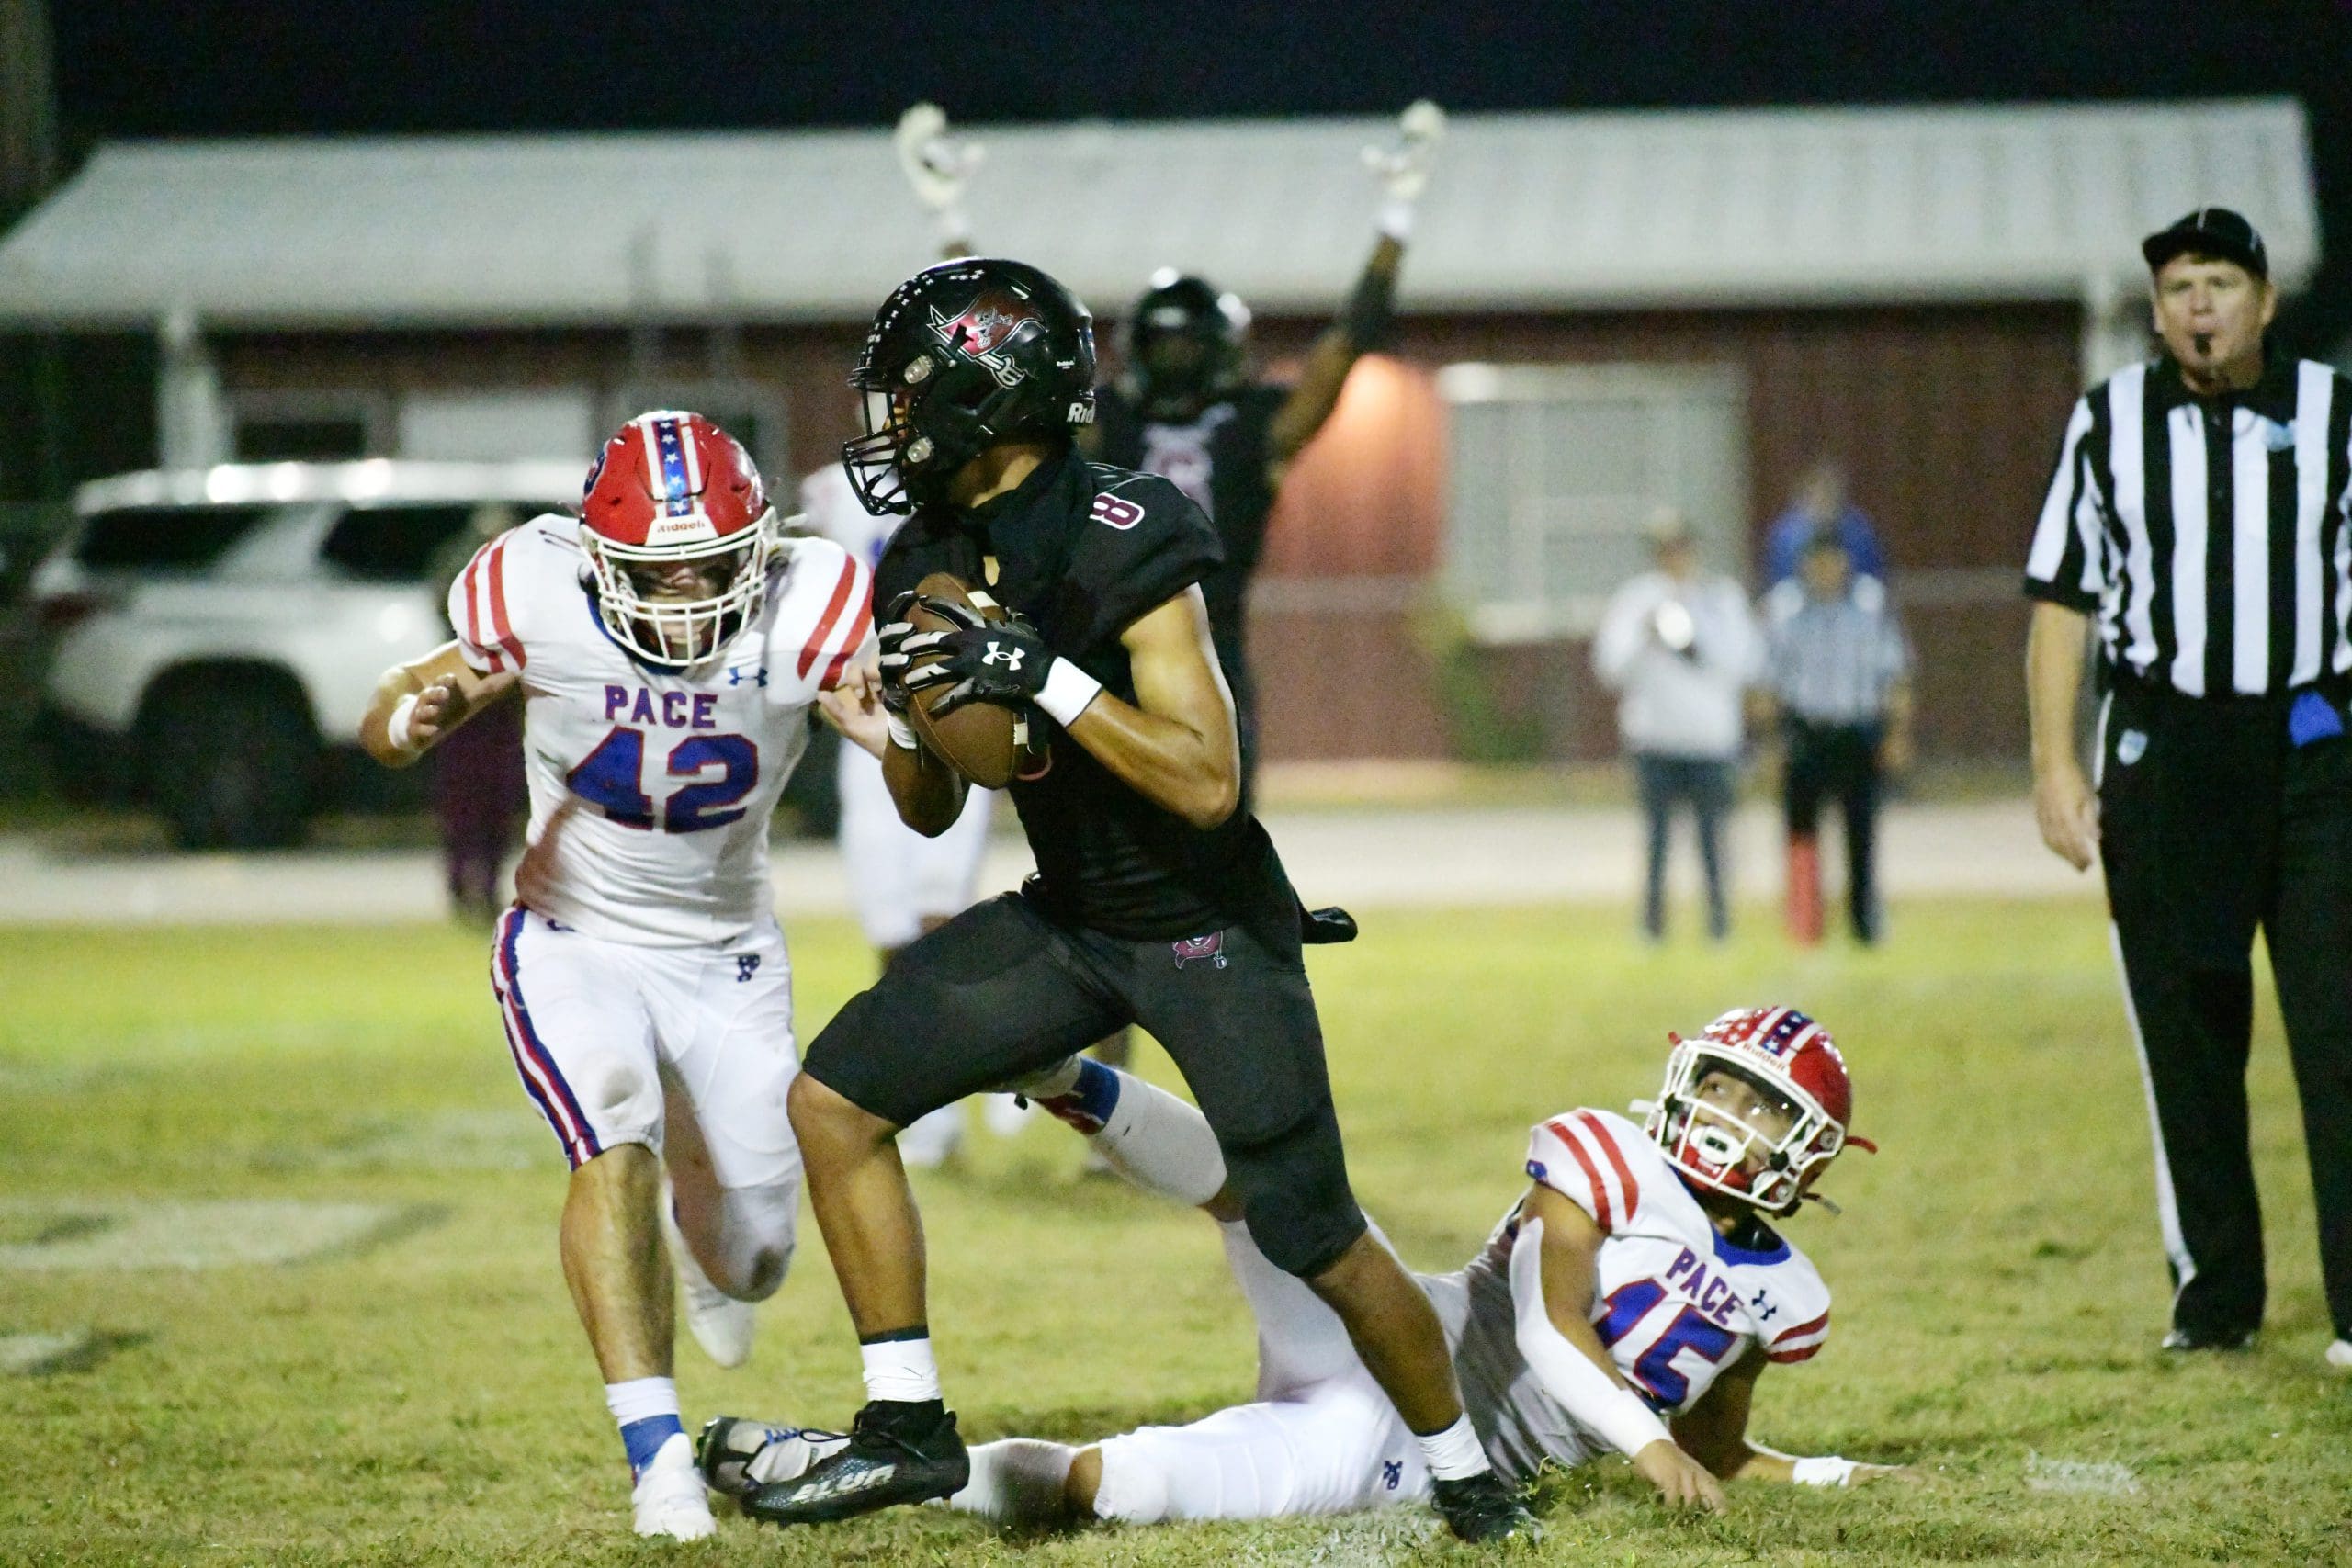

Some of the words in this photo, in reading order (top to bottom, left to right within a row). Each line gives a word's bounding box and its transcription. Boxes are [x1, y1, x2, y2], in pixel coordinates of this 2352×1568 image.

[1089, 492, 1145, 530] 8
[604, 684, 718, 728] PACE
[566, 724, 760, 834] 42
[1665, 1246, 1745, 1327] PACE
